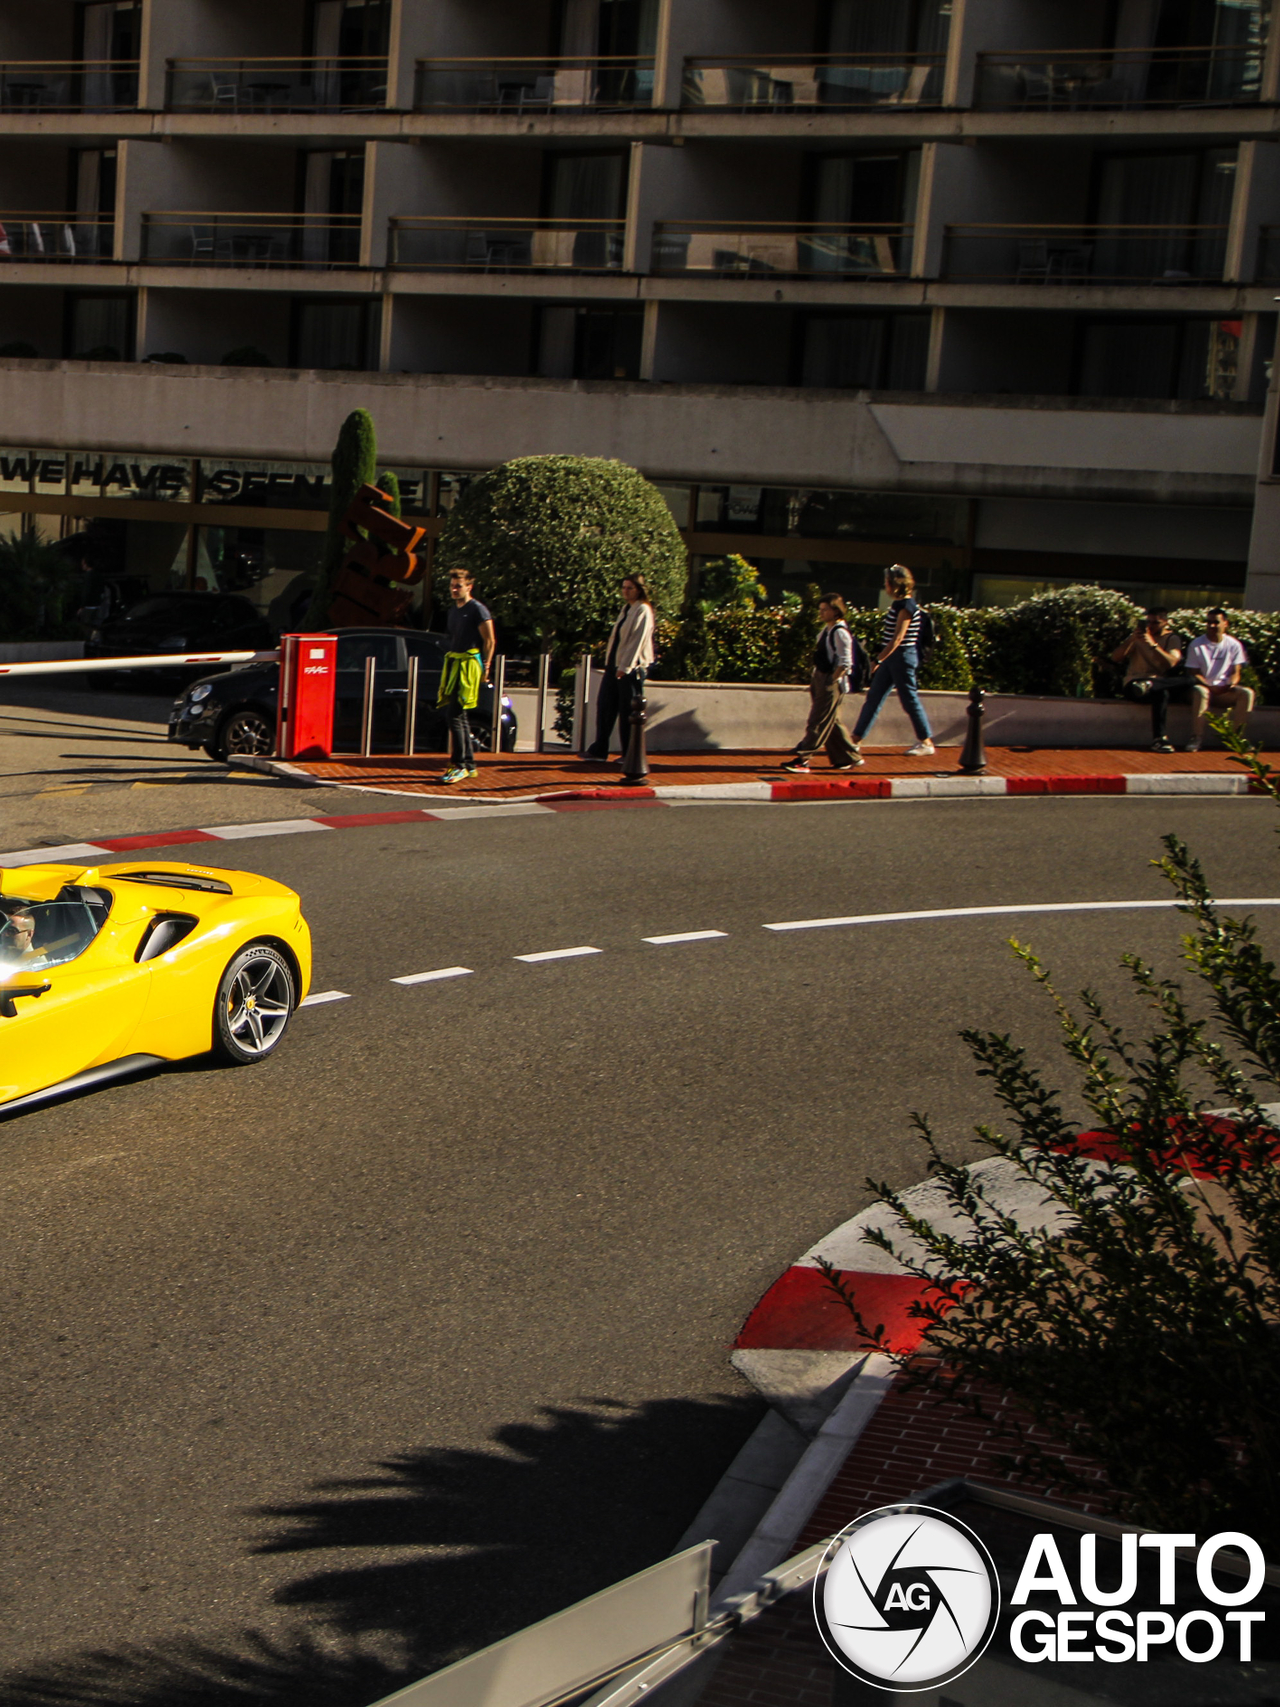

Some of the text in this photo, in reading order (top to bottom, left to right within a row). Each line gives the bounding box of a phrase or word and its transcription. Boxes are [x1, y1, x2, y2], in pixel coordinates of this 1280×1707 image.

[0, 456, 325, 498] WE HAVE SEEN
